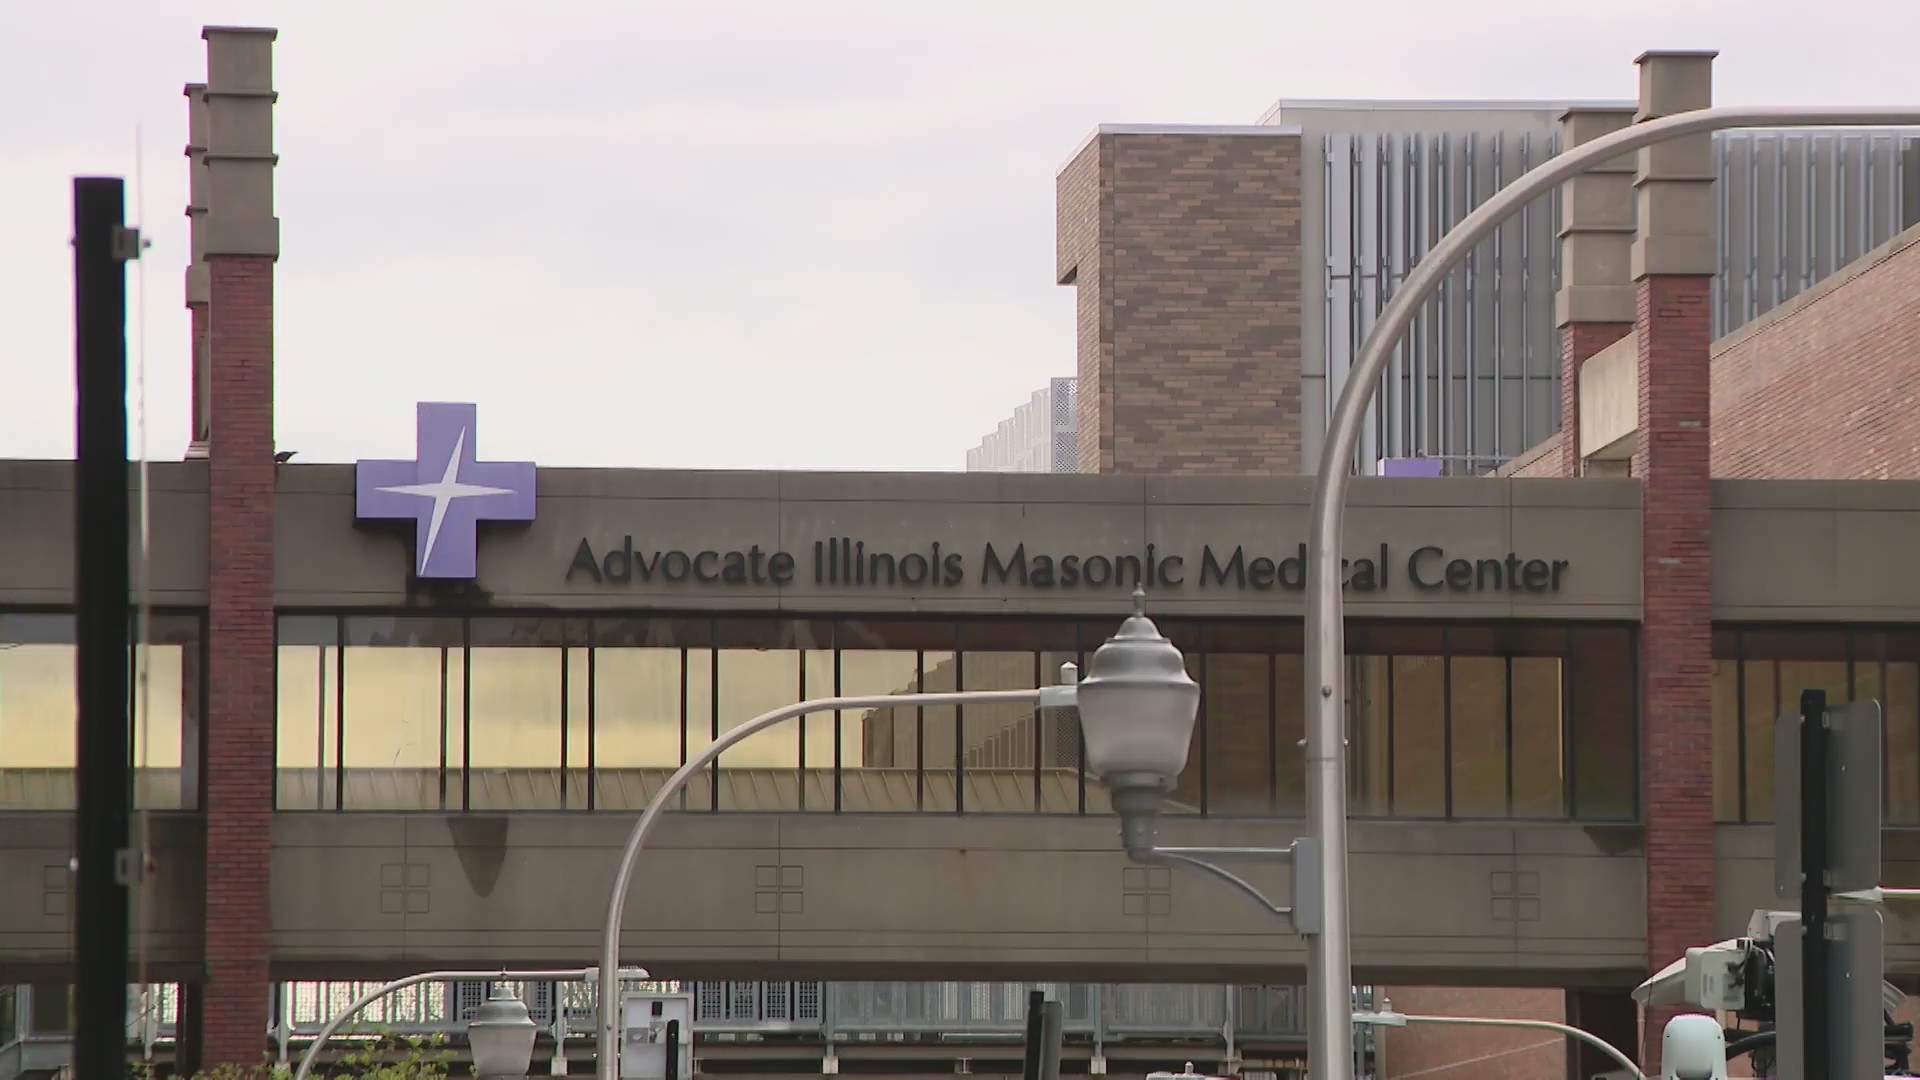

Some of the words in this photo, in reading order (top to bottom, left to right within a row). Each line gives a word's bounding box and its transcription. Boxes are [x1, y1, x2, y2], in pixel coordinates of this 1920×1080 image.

[565, 535, 796, 585] Advocate
[815, 536, 964, 585] Illinois
[982, 541, 1184, 587] Masonic
[1199, 543, 1389, 591] Medal
[1407, 546, 1569, 591] Center
